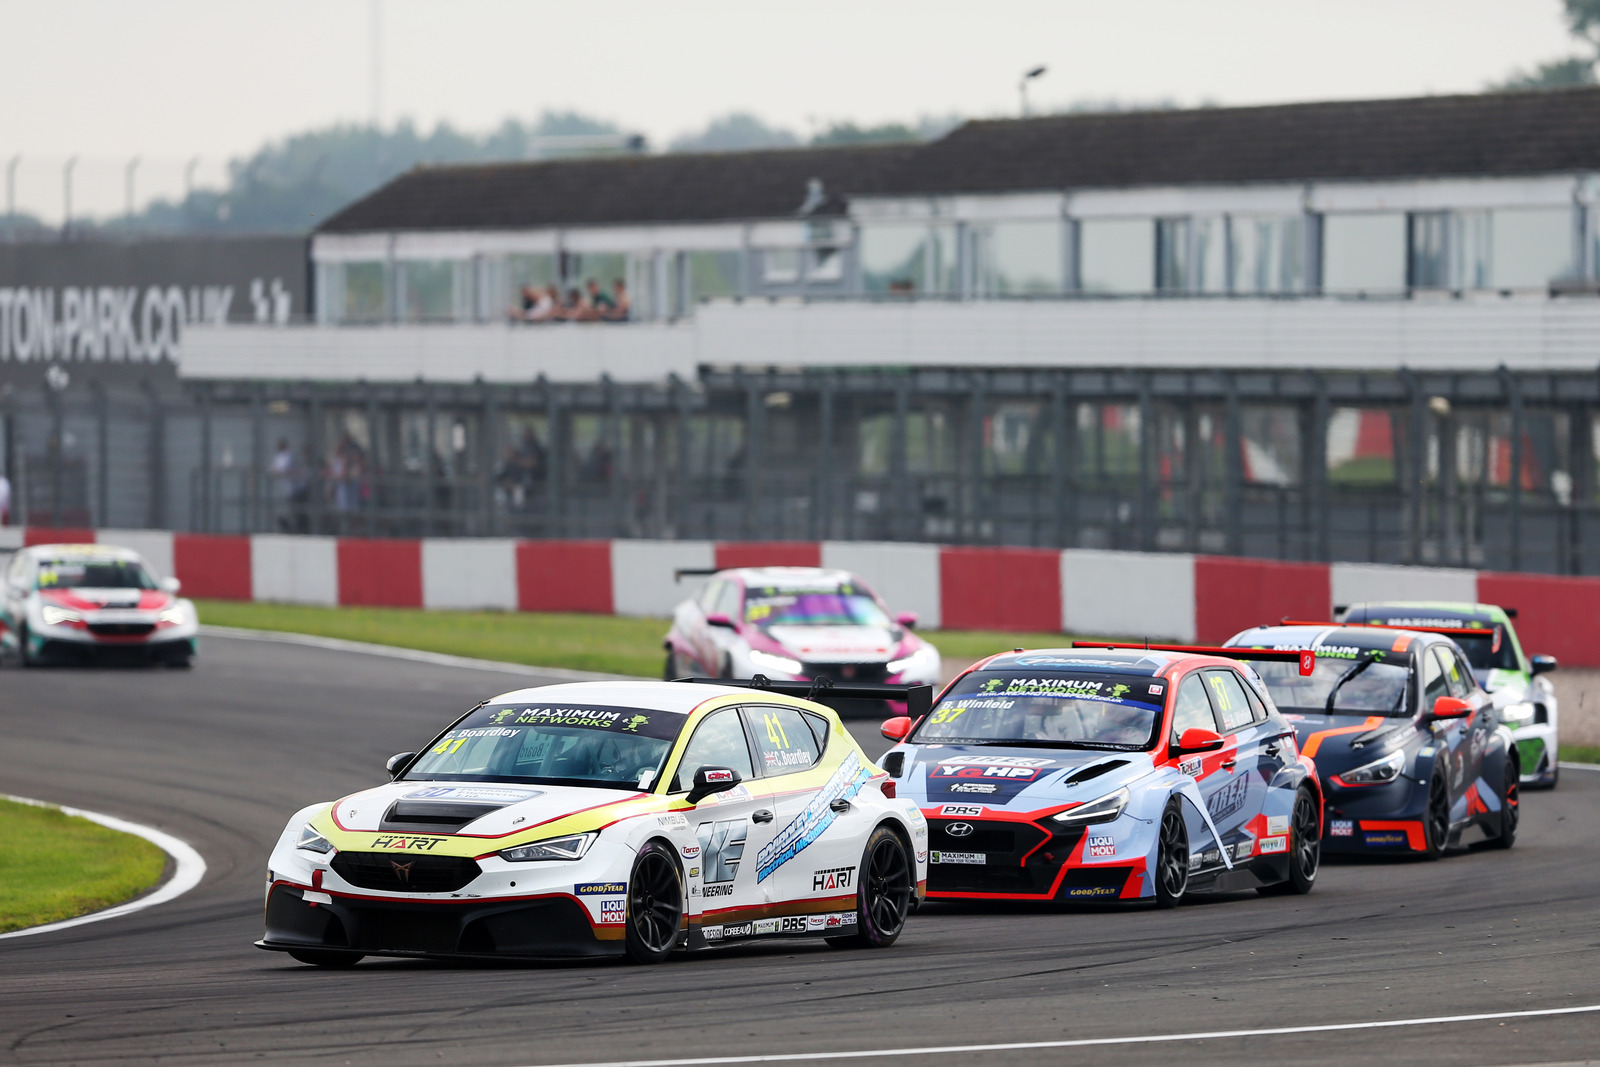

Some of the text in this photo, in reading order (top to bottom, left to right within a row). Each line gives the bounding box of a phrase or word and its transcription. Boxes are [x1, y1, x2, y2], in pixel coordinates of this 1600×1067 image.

[1009, 678, 1103, 690] MAXIMUM
[1006, 685, 1099, 696] NETWORKS
[1209, 676, 1232, 711] 37
[957, 699, 1016, 710] Winfield
[521, 708, 621, 721] MAXIMUM
[930, 708, 966, 725] 37
[514, 716, 613, 728] NETWORKS
[458, 727, 521, 739] Boardley
[763, 712, 790, 750] 41
[433, 738, 468, 755] 41
[657, 814, 686, 826] NIMBUS
[370, 836, 448, 850] HART
[1090, 837, 1113, 846] LIQUI
[683, 846, 699, 854] Torco
[1091, 846, 1115, 855] MOLY
[813, 866, 856, 891] HART
[580, 884, 624, 893] GOODYEAR
[1070, 887, 1116, 896] GOODYEAR
[602, 901, 624, 911] LIQUI
[602, 911, 624, 922] MOLY
[724, 926, 747, 936] CORBEAU
